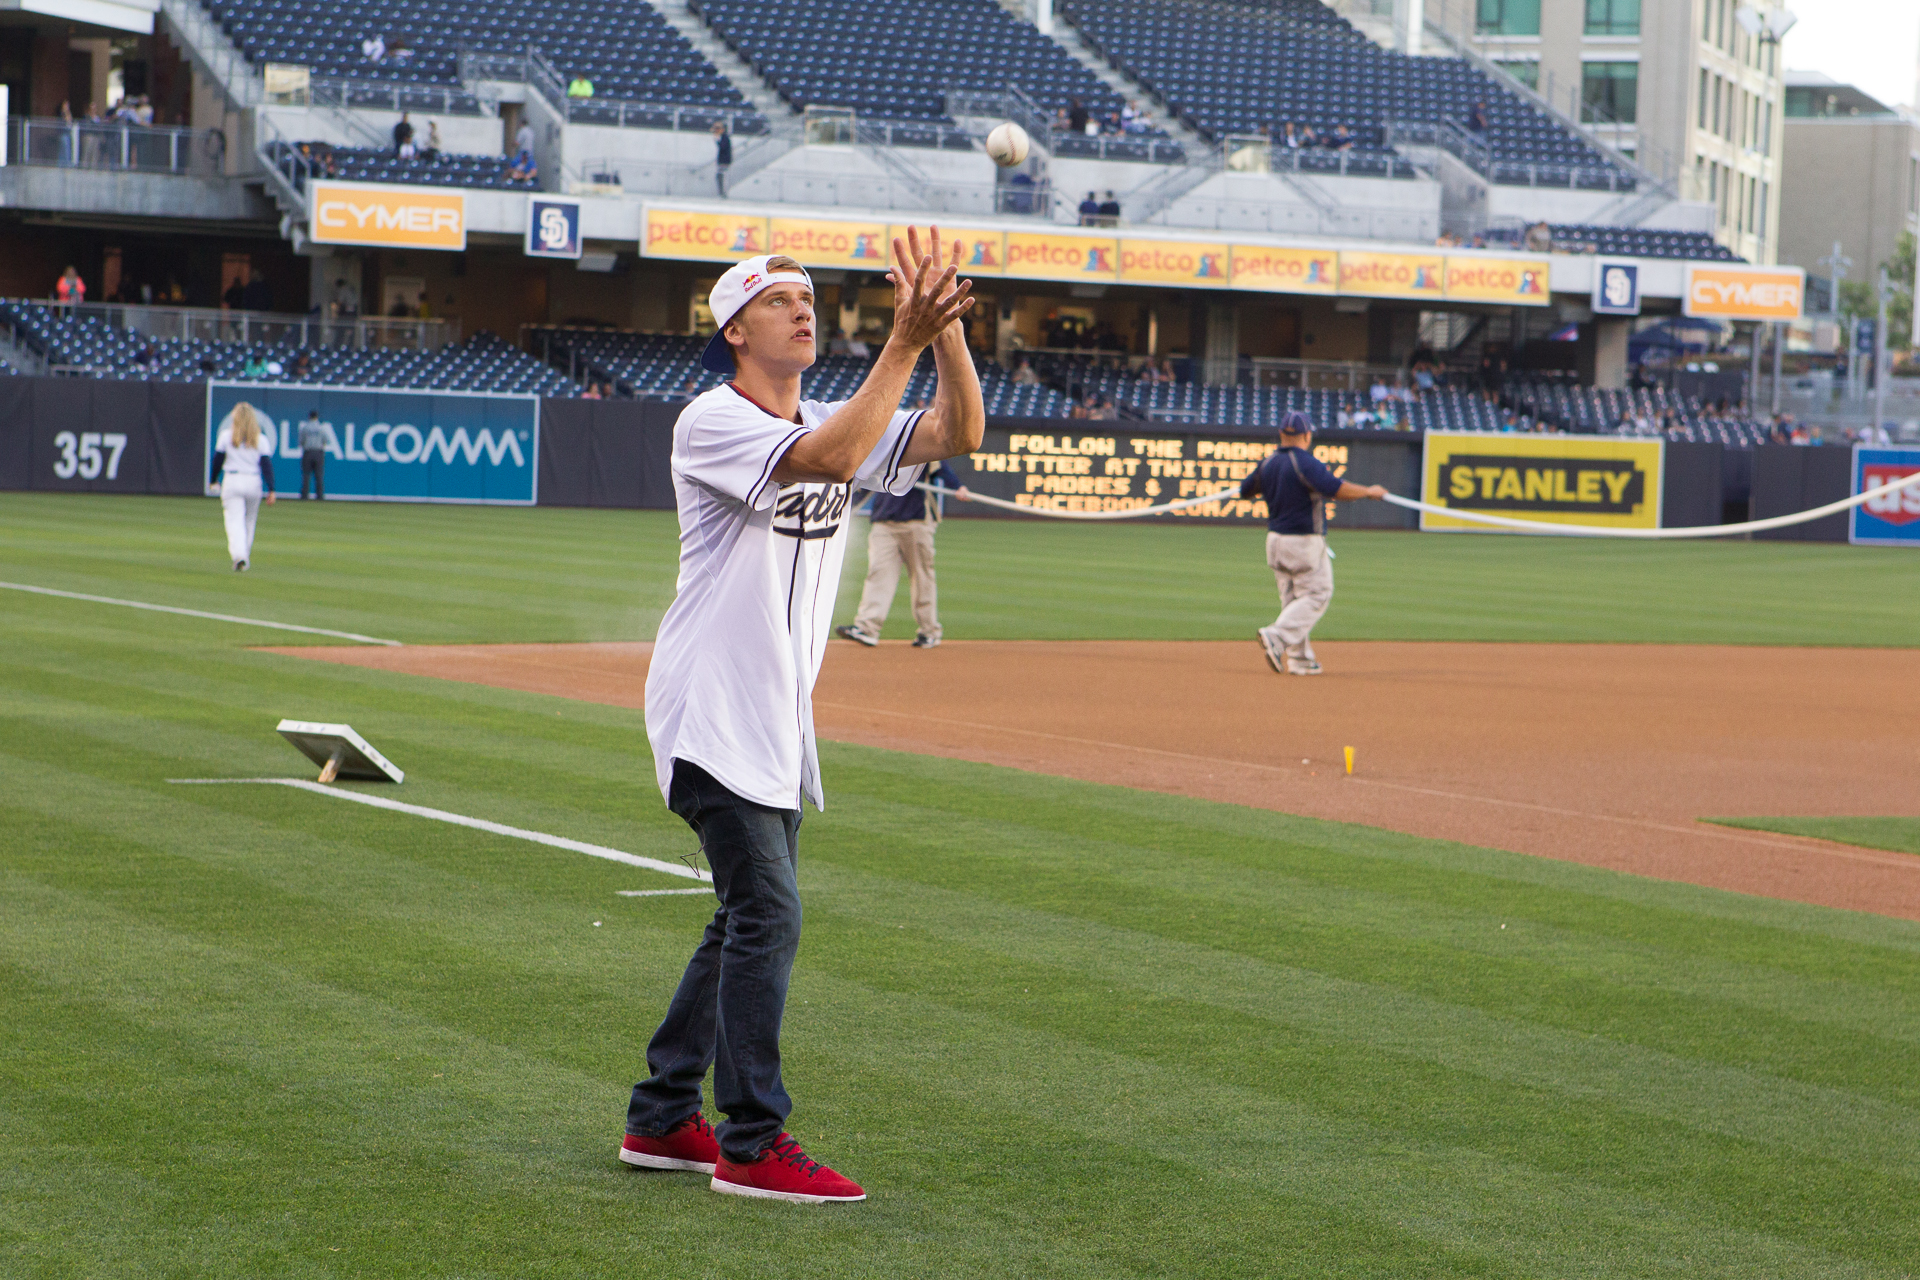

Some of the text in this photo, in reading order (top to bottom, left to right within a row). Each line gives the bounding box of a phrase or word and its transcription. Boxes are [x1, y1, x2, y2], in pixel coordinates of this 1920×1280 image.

[319, 201, 460, 233] CYMER
[648, 222, 729, 246] petco
[770, 229, 849, 254] petco
[1007, 243, 1082, 267] petco
[1120, 250, 1194, 274] petco
[1231, 255, 1304, 277] petco
[1338, 262, 1411, 284] petco
[1448, 267, 1517, 289] petco
[1692, 279, 1798, 308] CYMER
[53, 430, 128, 480] 357
[1010, 434, 1348, 464] FOLLOW THE PADRE ON
[970, 452, 1093, 474] TWITTER
[1105, 457, 1142, 477] AT
[1026, 474, 1131, 496] PADRES
[1145, 478, 1161, 497] &
[1450, 465, 1633, 504] STANLEY
